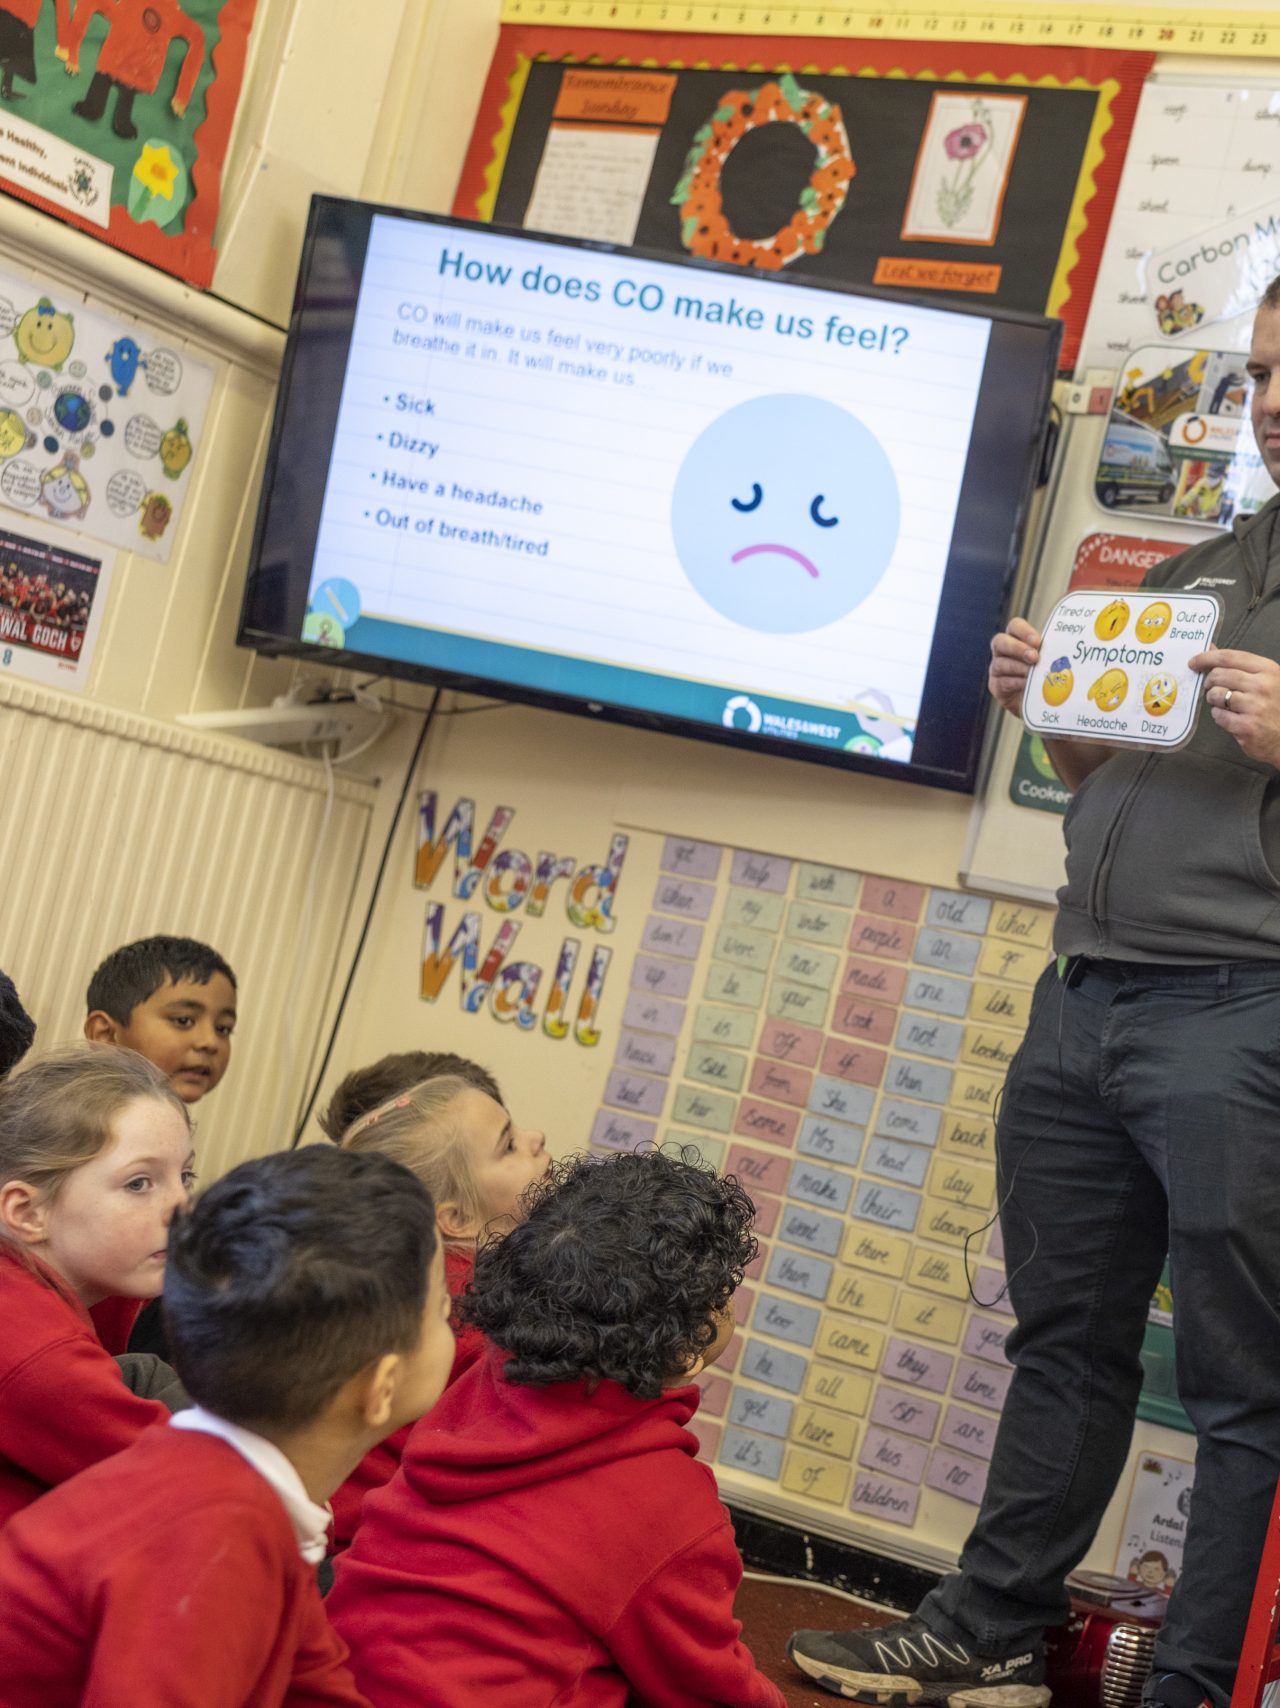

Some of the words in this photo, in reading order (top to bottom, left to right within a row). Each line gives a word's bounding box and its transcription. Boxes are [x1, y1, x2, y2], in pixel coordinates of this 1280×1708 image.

[1157, 232, 1249, 285] Carbon
[438, 248, 511, 287] How
[521, 265, 601, 301] does
[613, 279, 664, 312] CO
[673, 297, 764, 331] make
[775, 314, 814, 339] us
[825, 315, 909, 354] feel?
[397, 302, 428, 323] CO
[433, 310, 461, 329] will
[466, 314, 515, 339] make
[520, 326, 541, 343] us
[547, 330, 579, 350] feel
[585, 338, 624, 363] very
[628, 345, 686, 373] poorly
[691, 356, 702, 371] if
[707, 361, 733, 377] we
[393, 328, 460, 355] breathe
[466, 343, 476, 357] it
[508, 349, 519, 366] It
[525, 353, 553, 371] will
[558, 358, 608, 382] make
[395, 392, 435, 416] Sick
[389, 431, 440, 459] Dizzy
[382, 470, 429, 495] Have
[435, 484, 445, 497] a
[451, 484, 544, 516] headache
[376, 508, 410, 531] Out
[415, 517, 435, 534] of
[438, 521, 550, 557] breath/tired
[1058, 606, 1083, 617] Tired
[1084, 608, 1096, 616] or
[1176, 611, 1198, 623] Out
[1199, 612, 1211, 623] of
[1054, 621, 1085, 635] Sleepy
[1170, 628, 1205, 641] Breath
[1073, 640, 1164, 667] Symptoms
[1041, 711, 1060, 724] Sick
[1077, 715, 1128, 731] Headache
[1141, 720, 1169, 736] Dizzy
[1018, 779, 1074, 804] Cooker
[413, 790, 629, 934] Word
[936, 901, 969, 924] old
[996, 908, 1036, 937] what
[860, 925, 902, 951] people
[420, 900, 614, 1047] Wall
[913, 983, 945, 1001] one
[985, 990, 1015, 1017] like
[843, 1006, 874, 1030] look
[907, 1025, 939, 1047] not
[964, 1084, 991, 1104] and
[886, 1110, 919, 1134] come
[808, 1127, 834, 1151] Mrs
[950, 1126, 986, 1148] back
[876, 1146, 909, 1170] had
[797, 1173, 838, 1200] make
[942, 1171, 975, 1207] day
[860, 1189, 901, 1220] their
[929, 1211, 969, 1238] down
[917, 1256, 950, 1283] little
[837, 1278, 864, 1307] the
[915, 1305, 935, 1325] it
[828, 1329, 870, 1357] came
[896, 1349, 929, 1381] they
[815, 1375, 842, 1399] all
[963, 1373, 998, 1399] time
[889, 1402, 922, 1423] so
[953, 1422, 985, 1443] are
[734, 1442, 762, 1465] it's
[874, 1442, 902, 1467] his
[801, 1465, 826, 1492] of
[946, 1464, 970, 1485] no
[852, 1481, 909, 1513] children
[1152, 1513, 1184, 1533] Ardal
[981, 1663, 1001, 1677] XA
[1005, 1653, 1033, 1669] PRO
